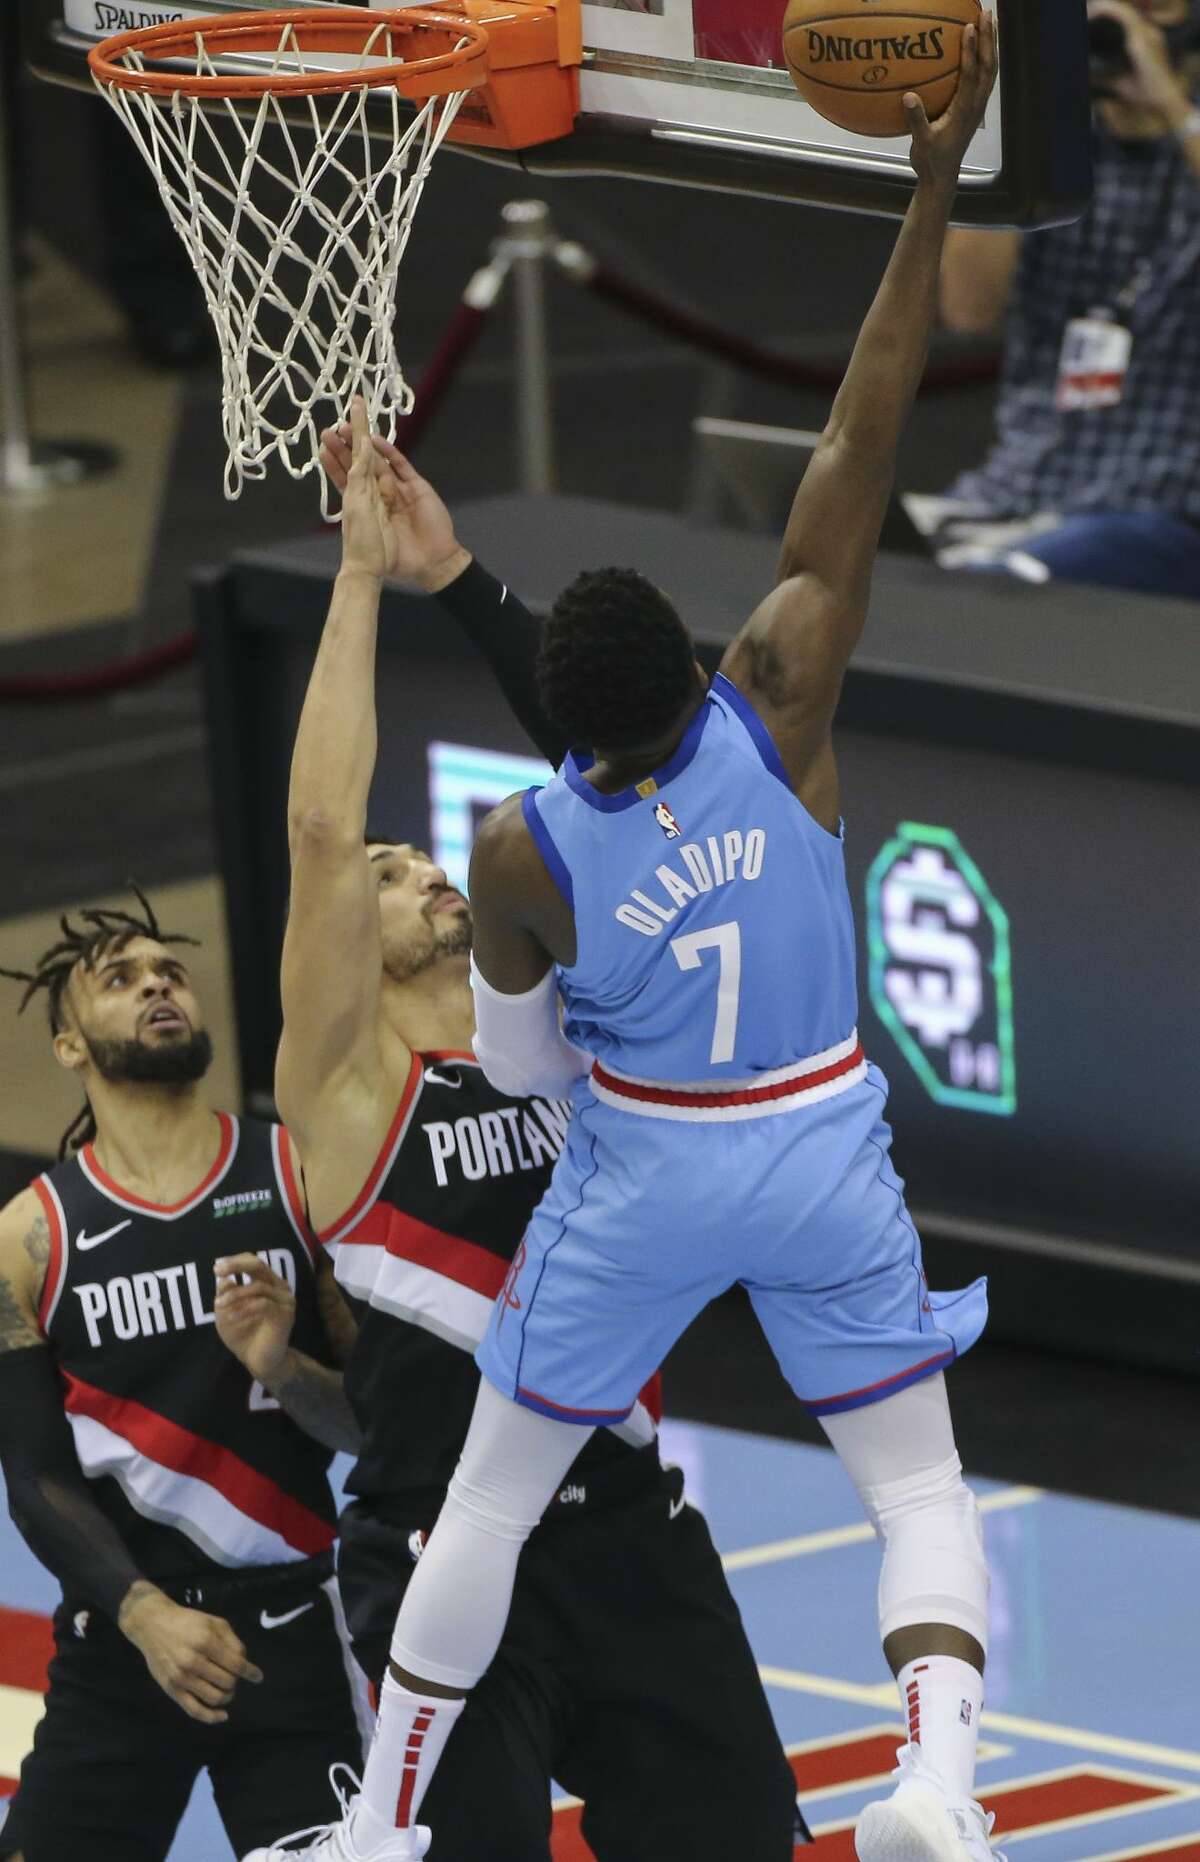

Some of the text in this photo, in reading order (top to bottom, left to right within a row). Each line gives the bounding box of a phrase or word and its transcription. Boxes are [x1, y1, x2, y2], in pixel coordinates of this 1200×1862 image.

[807, 26, 944, 63] SPALDING
[615, 828, 765, 936] OLADIPO
[669, 921, 740, 1064] 7
[421, 1099, 573, 1187] PORTLAN
[560, 1485, 586, 1504] city
